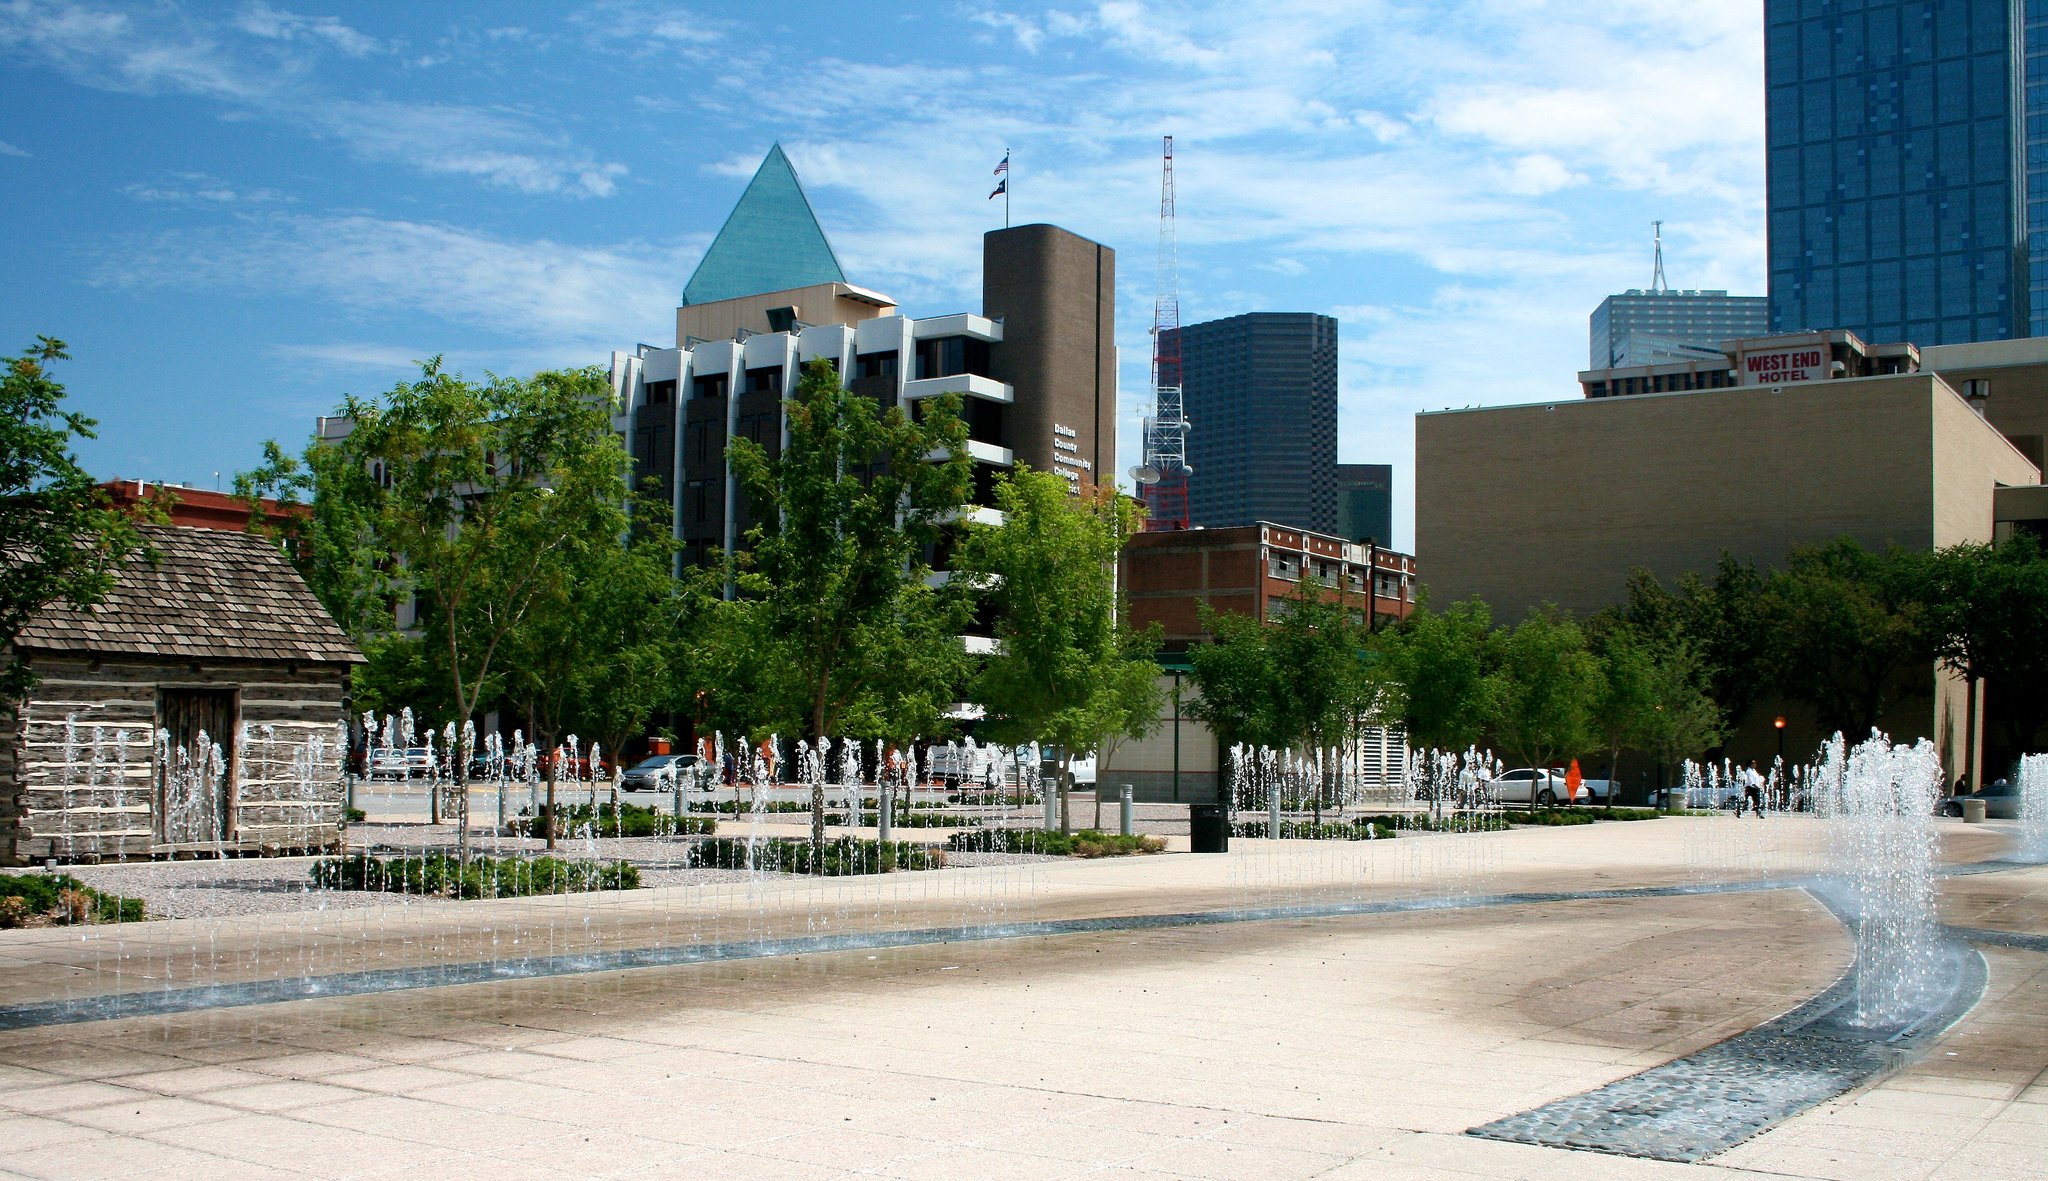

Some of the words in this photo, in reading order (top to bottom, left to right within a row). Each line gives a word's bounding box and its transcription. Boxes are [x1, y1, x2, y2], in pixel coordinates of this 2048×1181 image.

[1747, 354, 1788, 372] WEST
[1792, 351, 1820, 369] END
[1759, 370, 1809, 383] HOTEL
[1054, 423, 1076, 437] Dallas
[1054, 438, 1077, 453] County
[1054, 452, 1091, 470] Community
[1054, 466, 1079, 480] College
